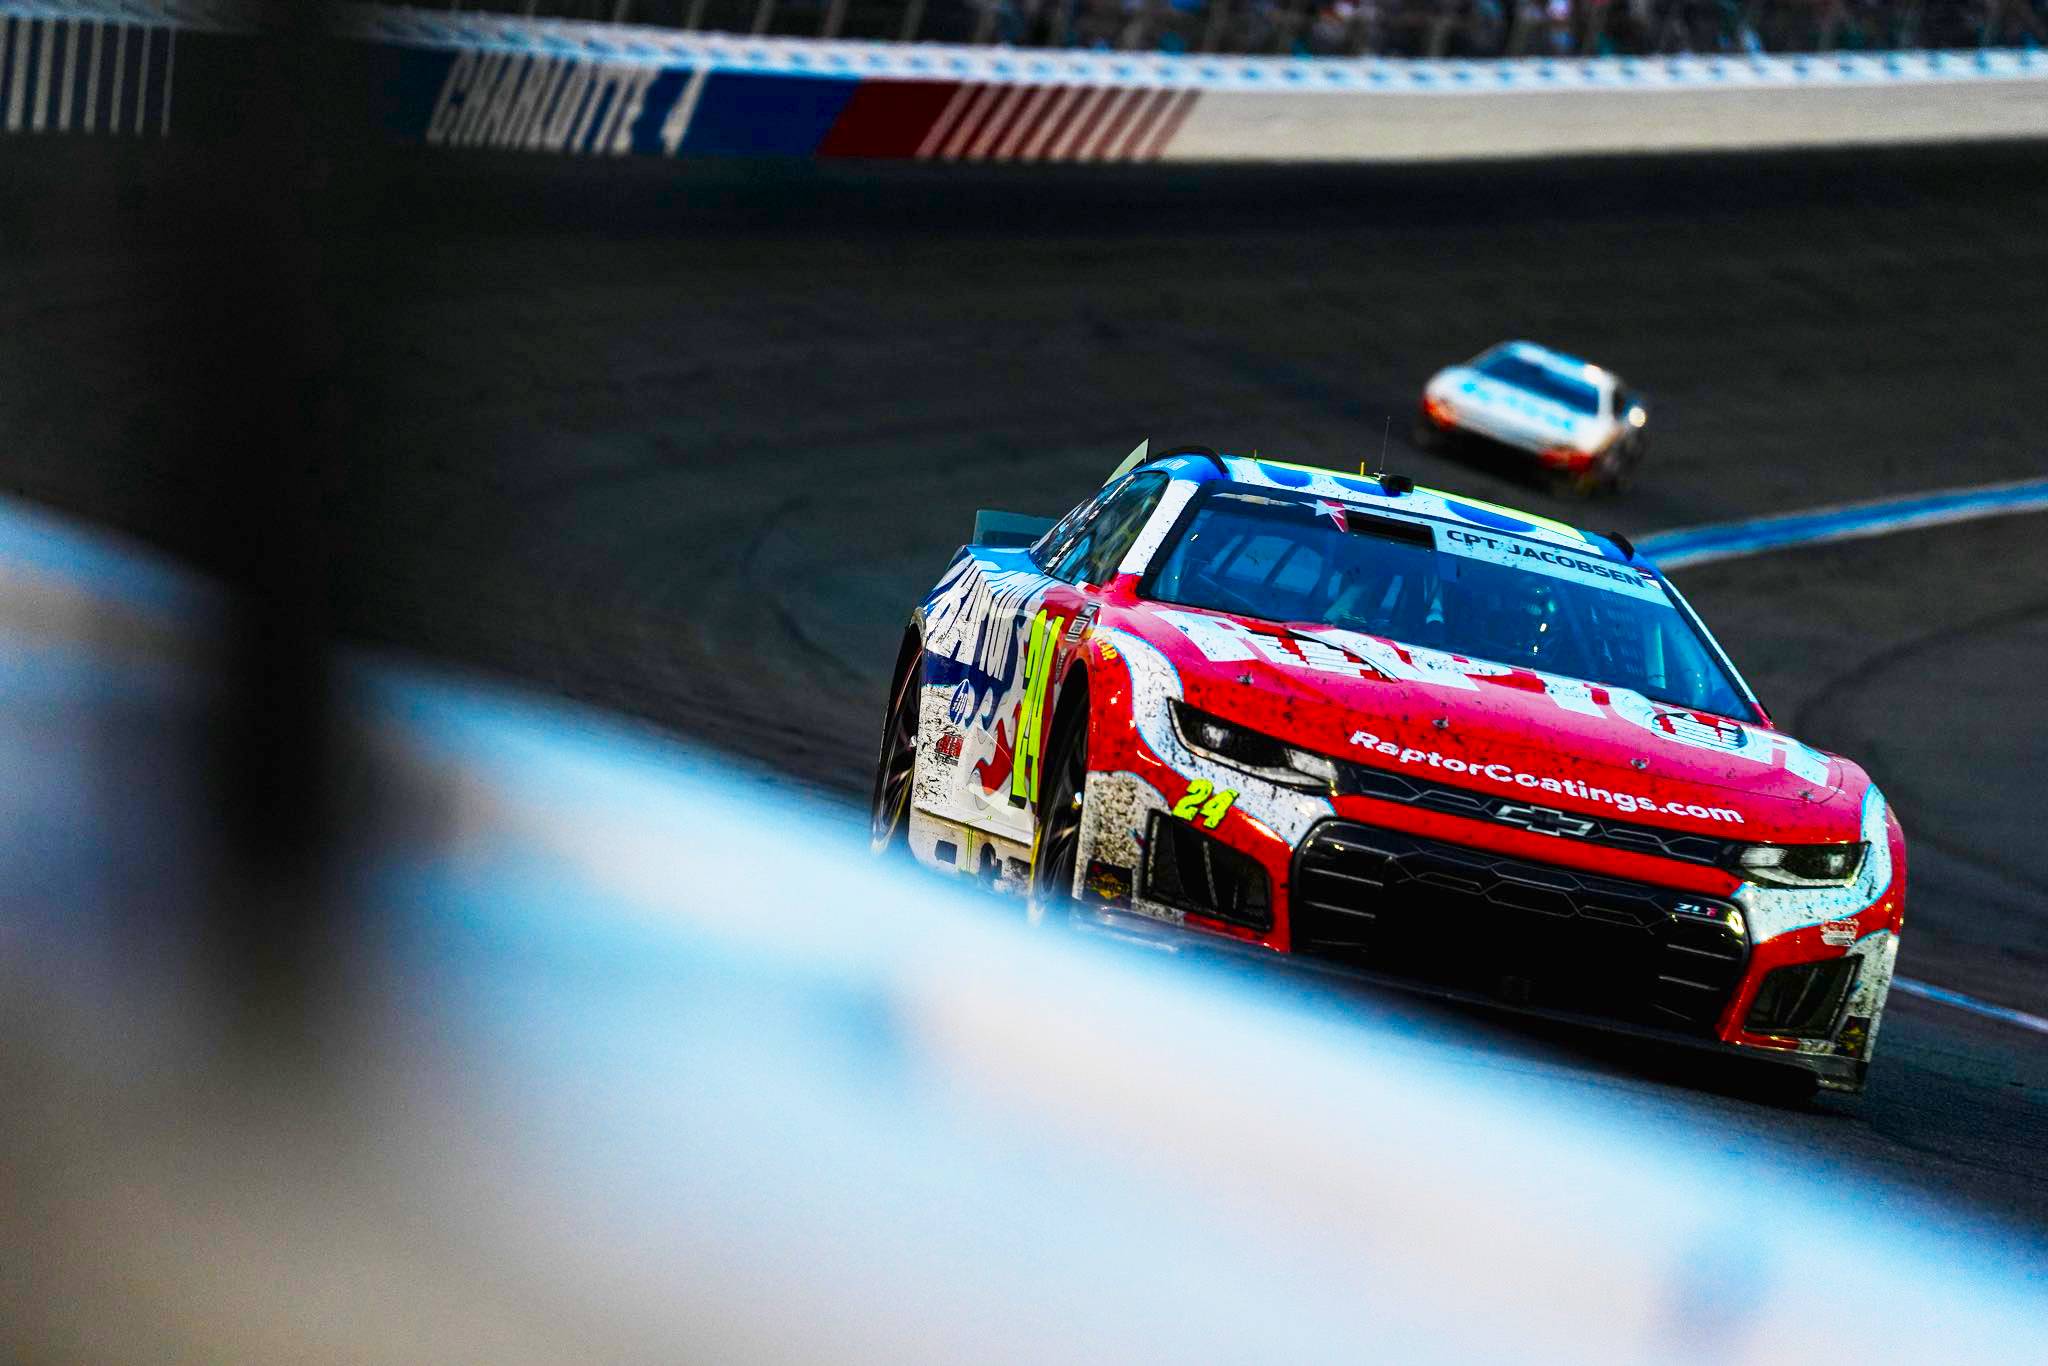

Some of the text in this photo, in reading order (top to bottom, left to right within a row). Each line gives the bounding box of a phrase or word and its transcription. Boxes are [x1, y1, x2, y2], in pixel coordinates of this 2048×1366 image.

[426, 50, 658, 153] CHARLOTTE
[1446, 530, 1645, 588] CPT JACOBSEN
[1172, 777, 1240, 829] 24
[1349, 729, 1745, 824] RaptorCoatings.com
